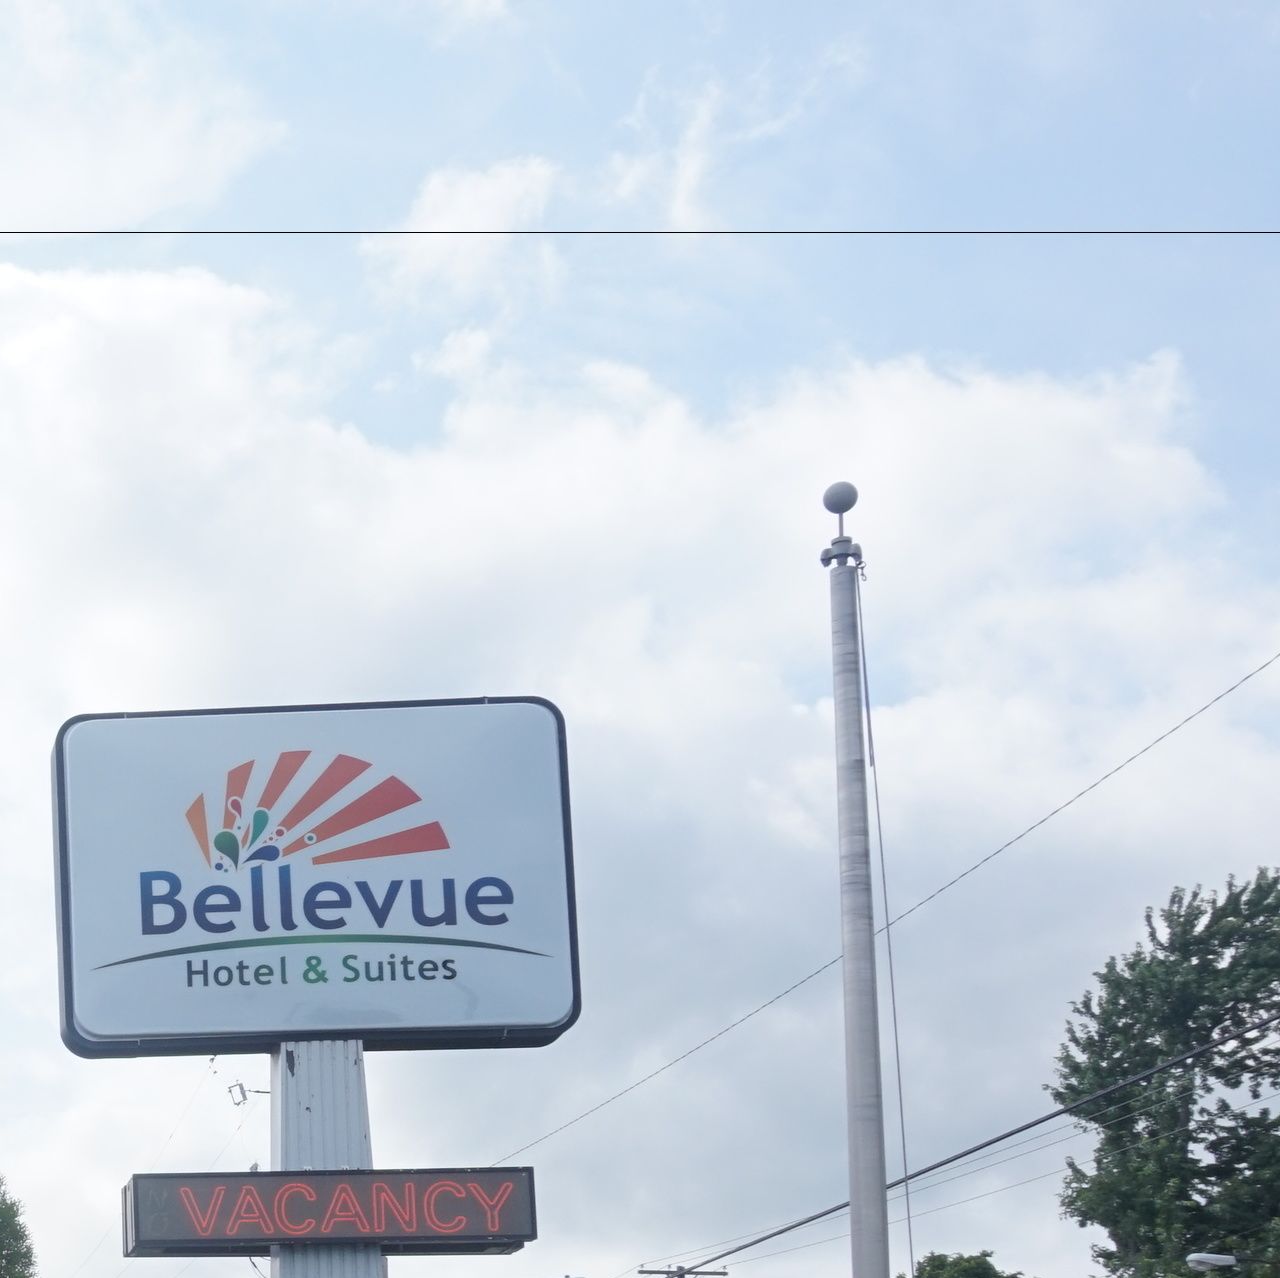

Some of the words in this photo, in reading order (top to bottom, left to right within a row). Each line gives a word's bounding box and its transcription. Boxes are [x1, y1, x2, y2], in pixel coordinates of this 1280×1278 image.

[140, 864, 514, 936] Bellevue
[185, 957, 288, 988] Hotel
[303, 956, 329, 984] &
[342, 954, 458, 983] Suites
[180, 1180, 514, 1236] VACANCY
